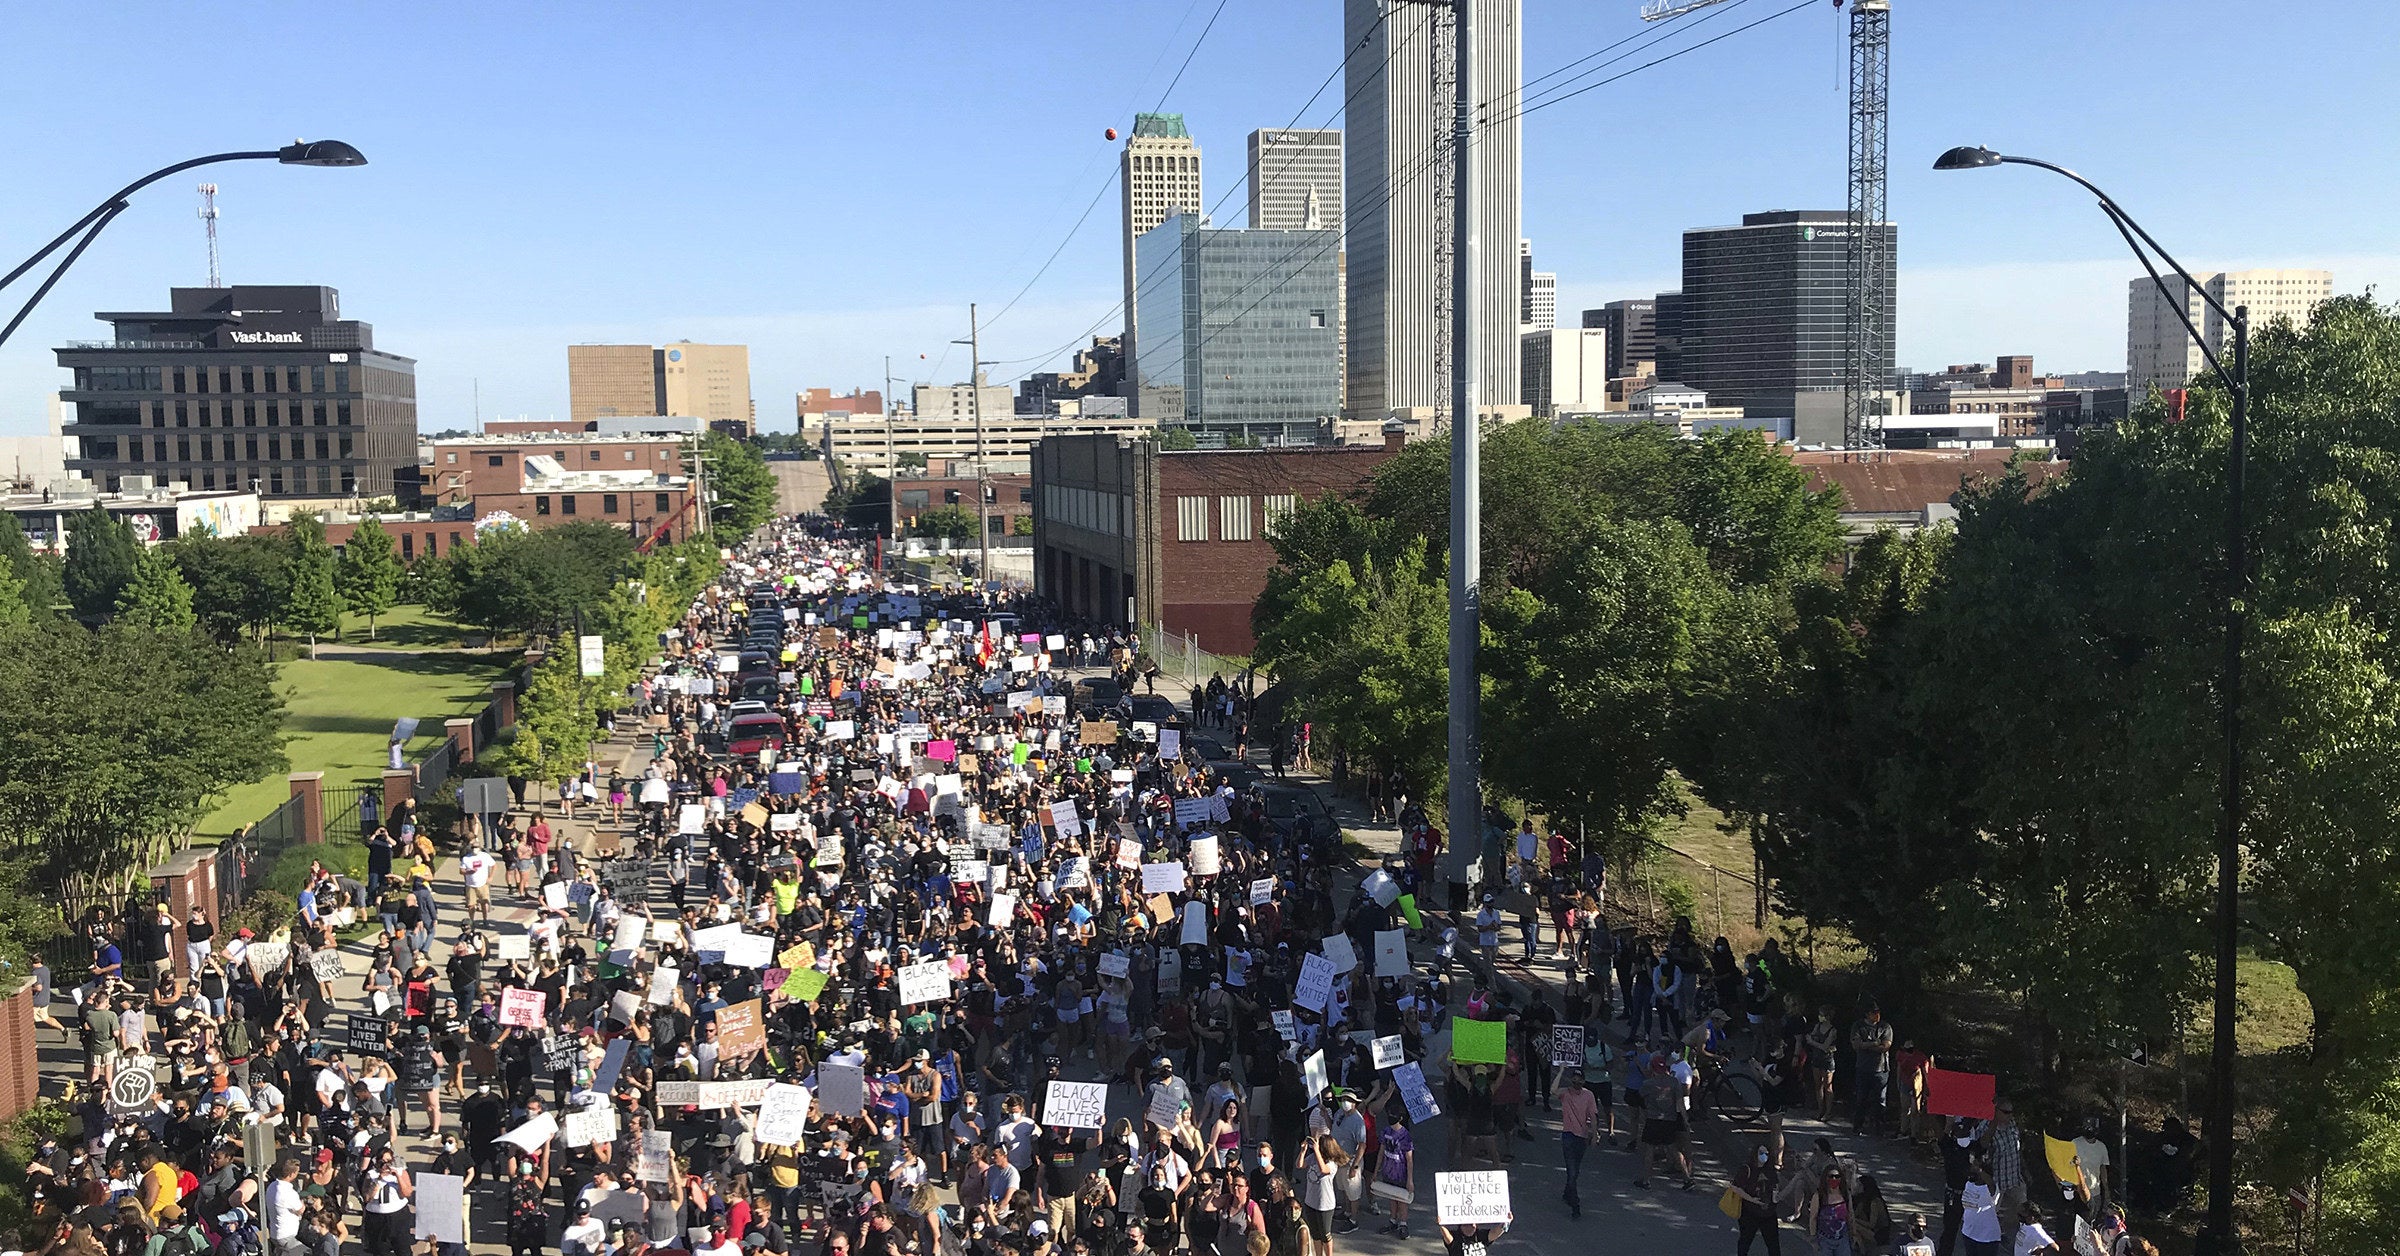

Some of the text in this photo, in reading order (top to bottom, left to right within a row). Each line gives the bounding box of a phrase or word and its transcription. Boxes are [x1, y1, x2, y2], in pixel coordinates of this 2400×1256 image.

[229, 331, 303, 343] Vast.bank
[1306, 955, 1334, 973] BLACK
[904, 963, 944, 980] BLACK
[1303, 969, 1329, 988] LIVES
[509, 990, 539, 1002] JUSTICE
[1297, 985, 1328, 1002] MATTER
[351, 1020, 382, 1032] BLACK
[351, 1030, 376, 1041] LIVES
[1555, 1029, 1573, 1039] SAY
[350, 1039, 385, 1052] MATTER
[1555, 1051, 1580, 1063] FLOYD
[718, 1088, 766, 1104] DE-ESCALA
[1052, 1083, 1100, 1102] BLACK
[1058, 1099, 1100, 1114] LIVES
[1046, 1110, 1102, 1127] MATTER
[1448, 1172, 1493, 1184] POLICE
[1442, 1183, 1501, 1195] VIOLENCE
[1462, 1194, 1473, 1206] IS
[1445, 1205, 1507, 1217] TERRORISM
